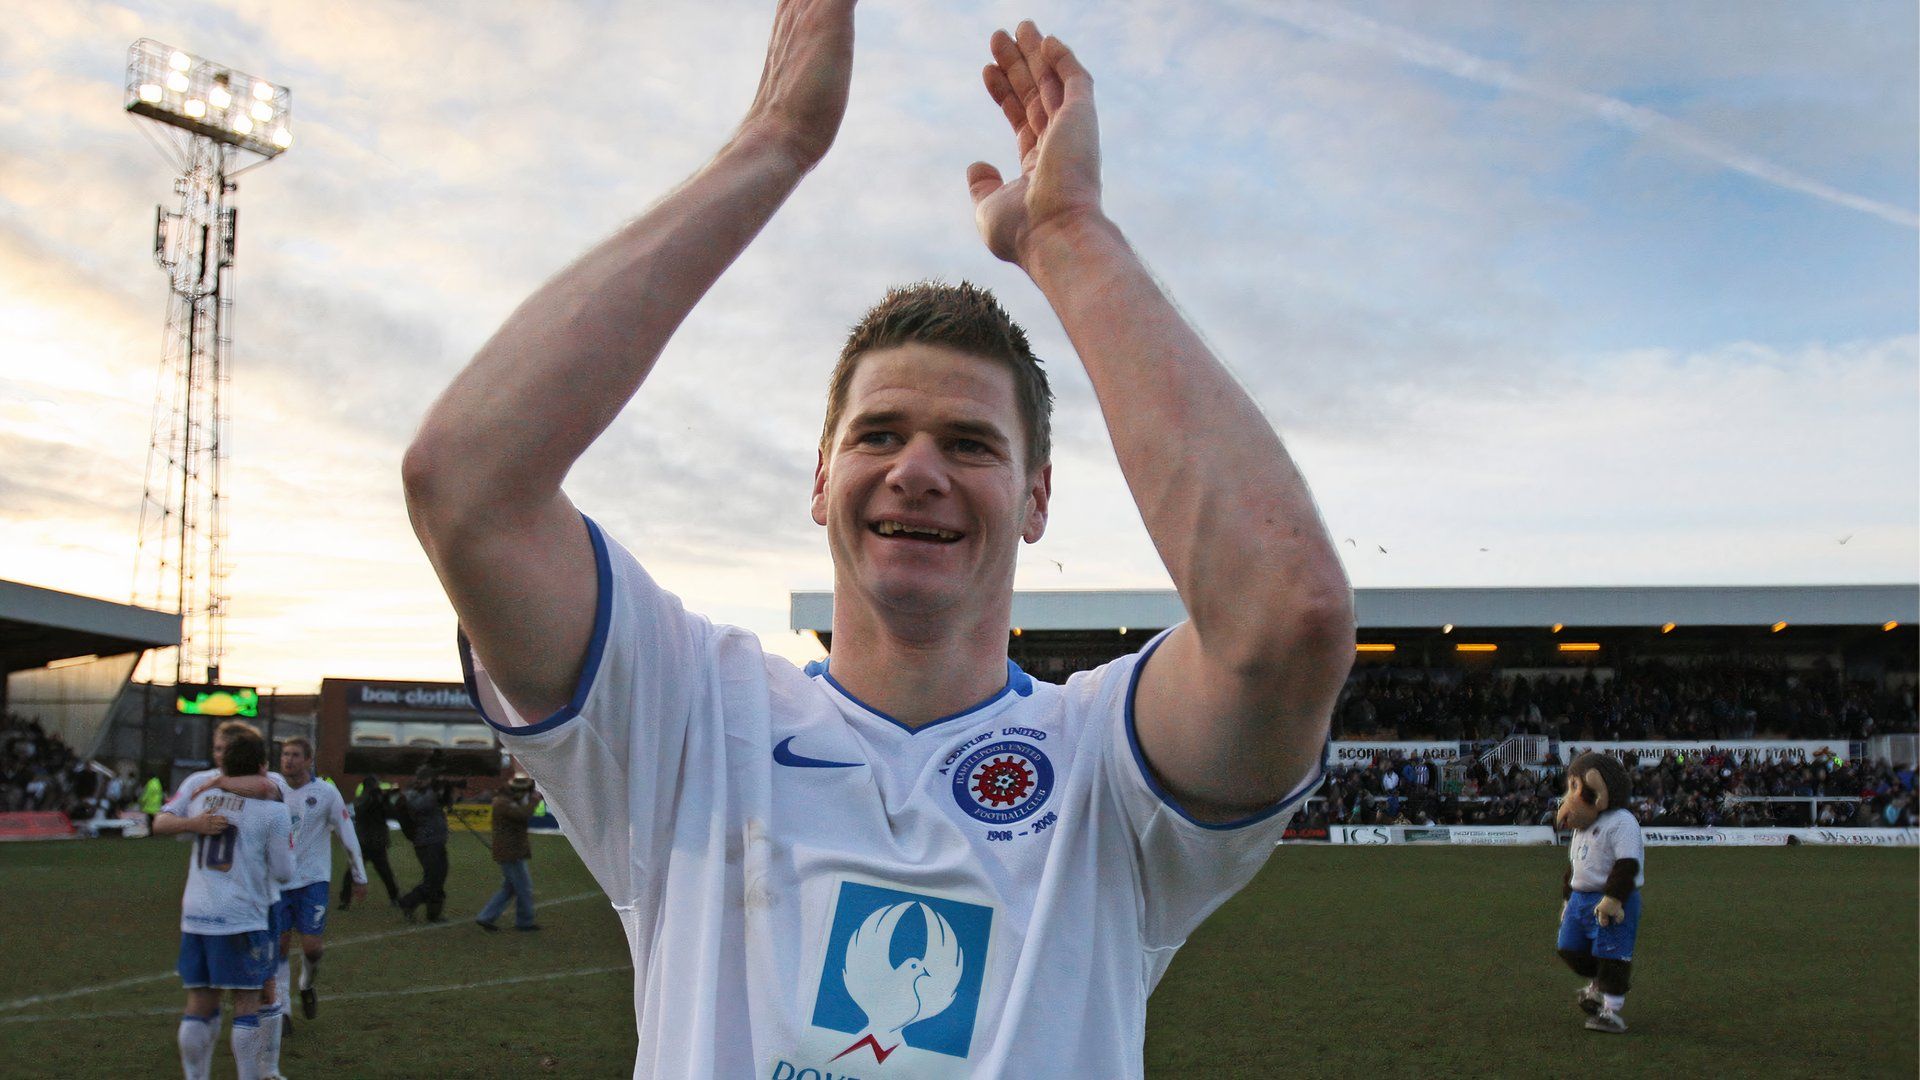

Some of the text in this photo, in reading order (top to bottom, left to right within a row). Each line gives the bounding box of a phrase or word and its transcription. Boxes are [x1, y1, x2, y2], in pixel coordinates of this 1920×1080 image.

[361, 685, 473, 706] box-clothin
[938, 727, 1047, 777] A CENTURY UNITED
[956, 744, 1042, 784] HARTLEPOOL UNITED
[1410, 747, 1457, 760] AGER
[974, 789, 1046, 821] FOOTBALL CLUB
[986, 830, 1013, 841] 1908
[1031, 811, 1058, 834] 2008
[312, 904, 326, 929] 7
